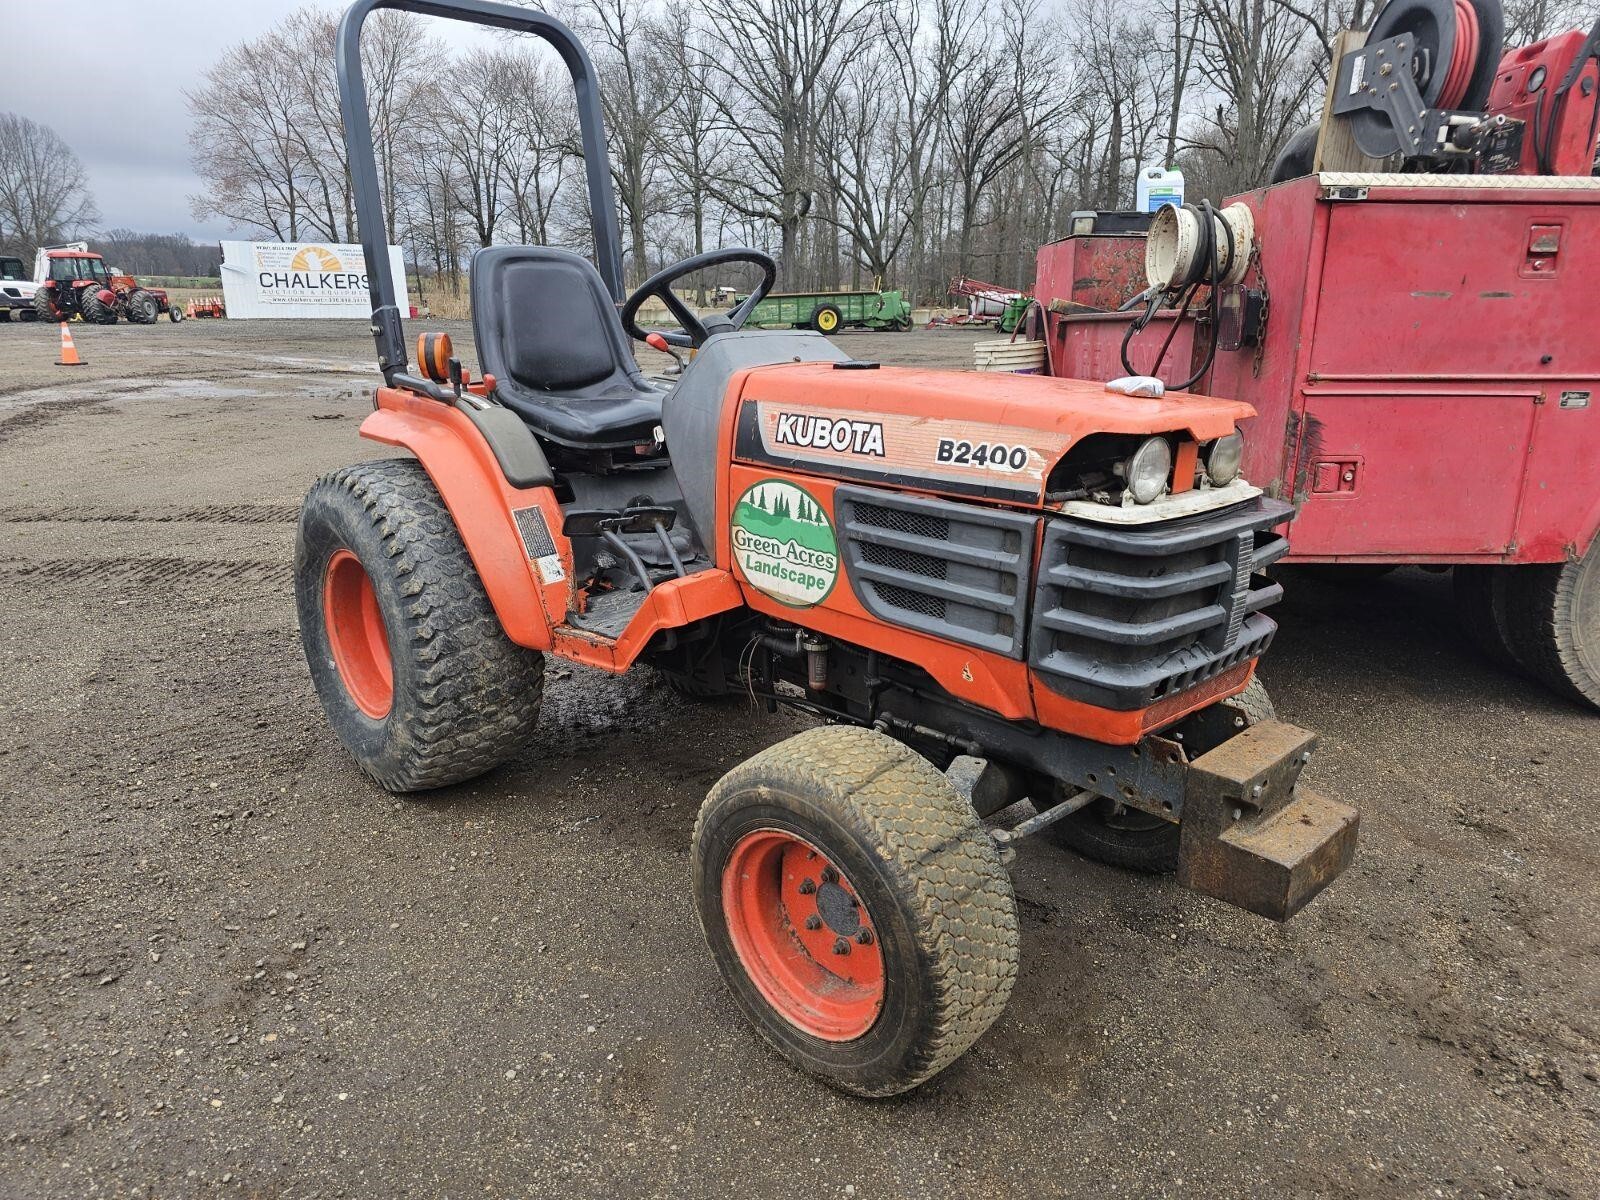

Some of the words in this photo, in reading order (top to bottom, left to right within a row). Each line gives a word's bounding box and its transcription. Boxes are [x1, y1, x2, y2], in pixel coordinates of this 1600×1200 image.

[259, 272, 370, 290] CHALKERS
[775, 412, 885, 457] KUBOTA
[936, 438, 1028, 471] B2400
[733, 529, 781, 556] Green
[786, 542, 835, 570] Acres
[745, 553, 826, 591] Landscape
